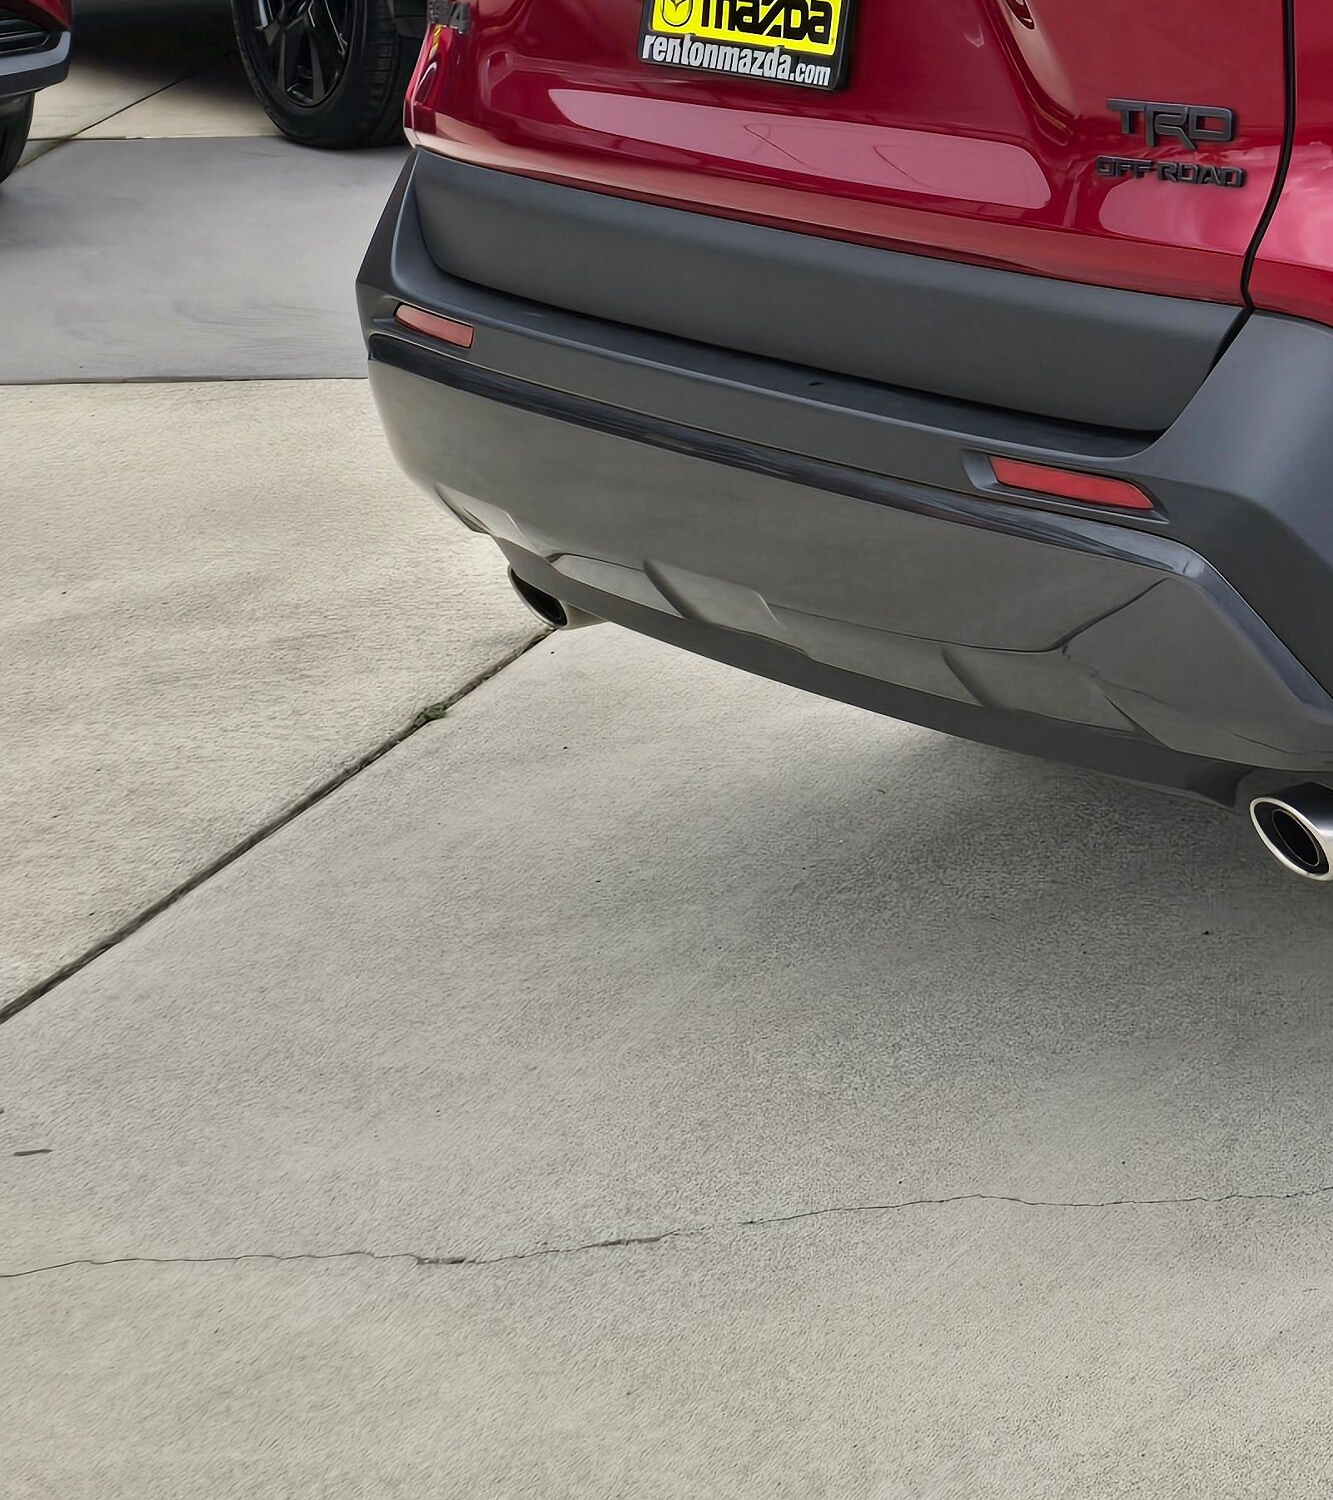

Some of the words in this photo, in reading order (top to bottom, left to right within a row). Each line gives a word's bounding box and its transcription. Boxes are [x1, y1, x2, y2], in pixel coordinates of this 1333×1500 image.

[642, 34, 831, 87] rentonmazda.com
[1106, 98, 1234, 150] TRD
[1096, 155, 1153, 179] OFF
[1157, 161, 1247, 187] ROAD
